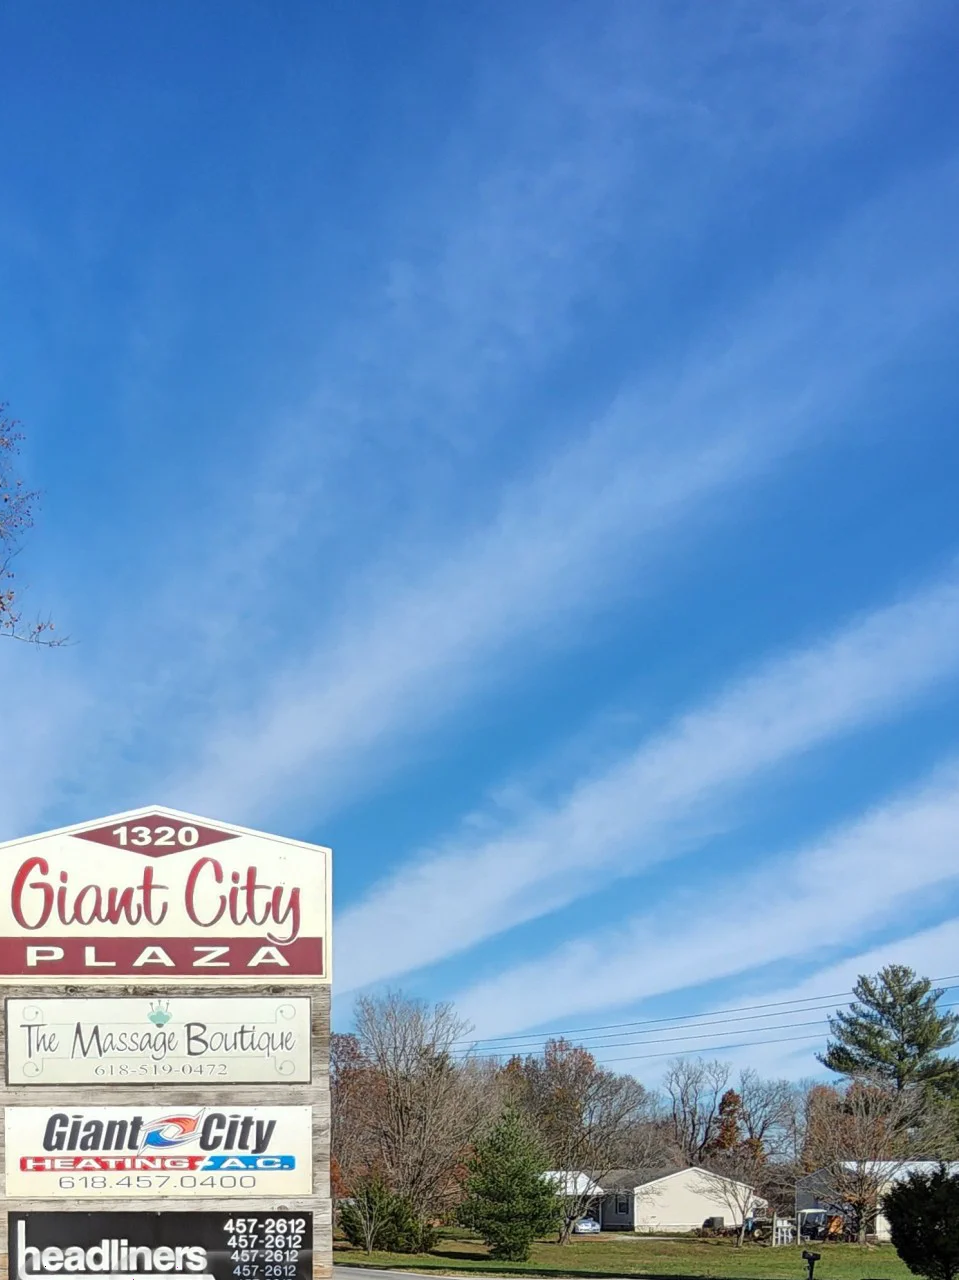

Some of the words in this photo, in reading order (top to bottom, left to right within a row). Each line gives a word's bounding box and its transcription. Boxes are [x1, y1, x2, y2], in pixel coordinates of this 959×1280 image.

[112, 826, 199, 846] 1320
[11, 856, 169, 930] Giant
[185, 856, 300, 945] City
[26, 946, 290, 967] PLAZA
[20, 1023, 59, 1059] The
[70, 1021, 179, 1061] Massage
[184, 1021, 296, 1058] Boutique
[94, 1063, 228, 1076] 618-519-0472
[42, 1112, 144, 1151] Giant
[199, 1112, 277, 1154] City
[26, 1157, 188, 1170] HEATING
[219, 1157, 290, 1169] A.C.
[58, 1175, 256, 1189] 618.457.0400
[223, 1218, 306, 1234] 457-2612
[17, 1220, 212, 1278] headliners
[227, 1235, 302, 1248] 457-2612
[231, 1250, 298, 1262] 457-2612
[233, 1265, 296, 1276] 457-2612
